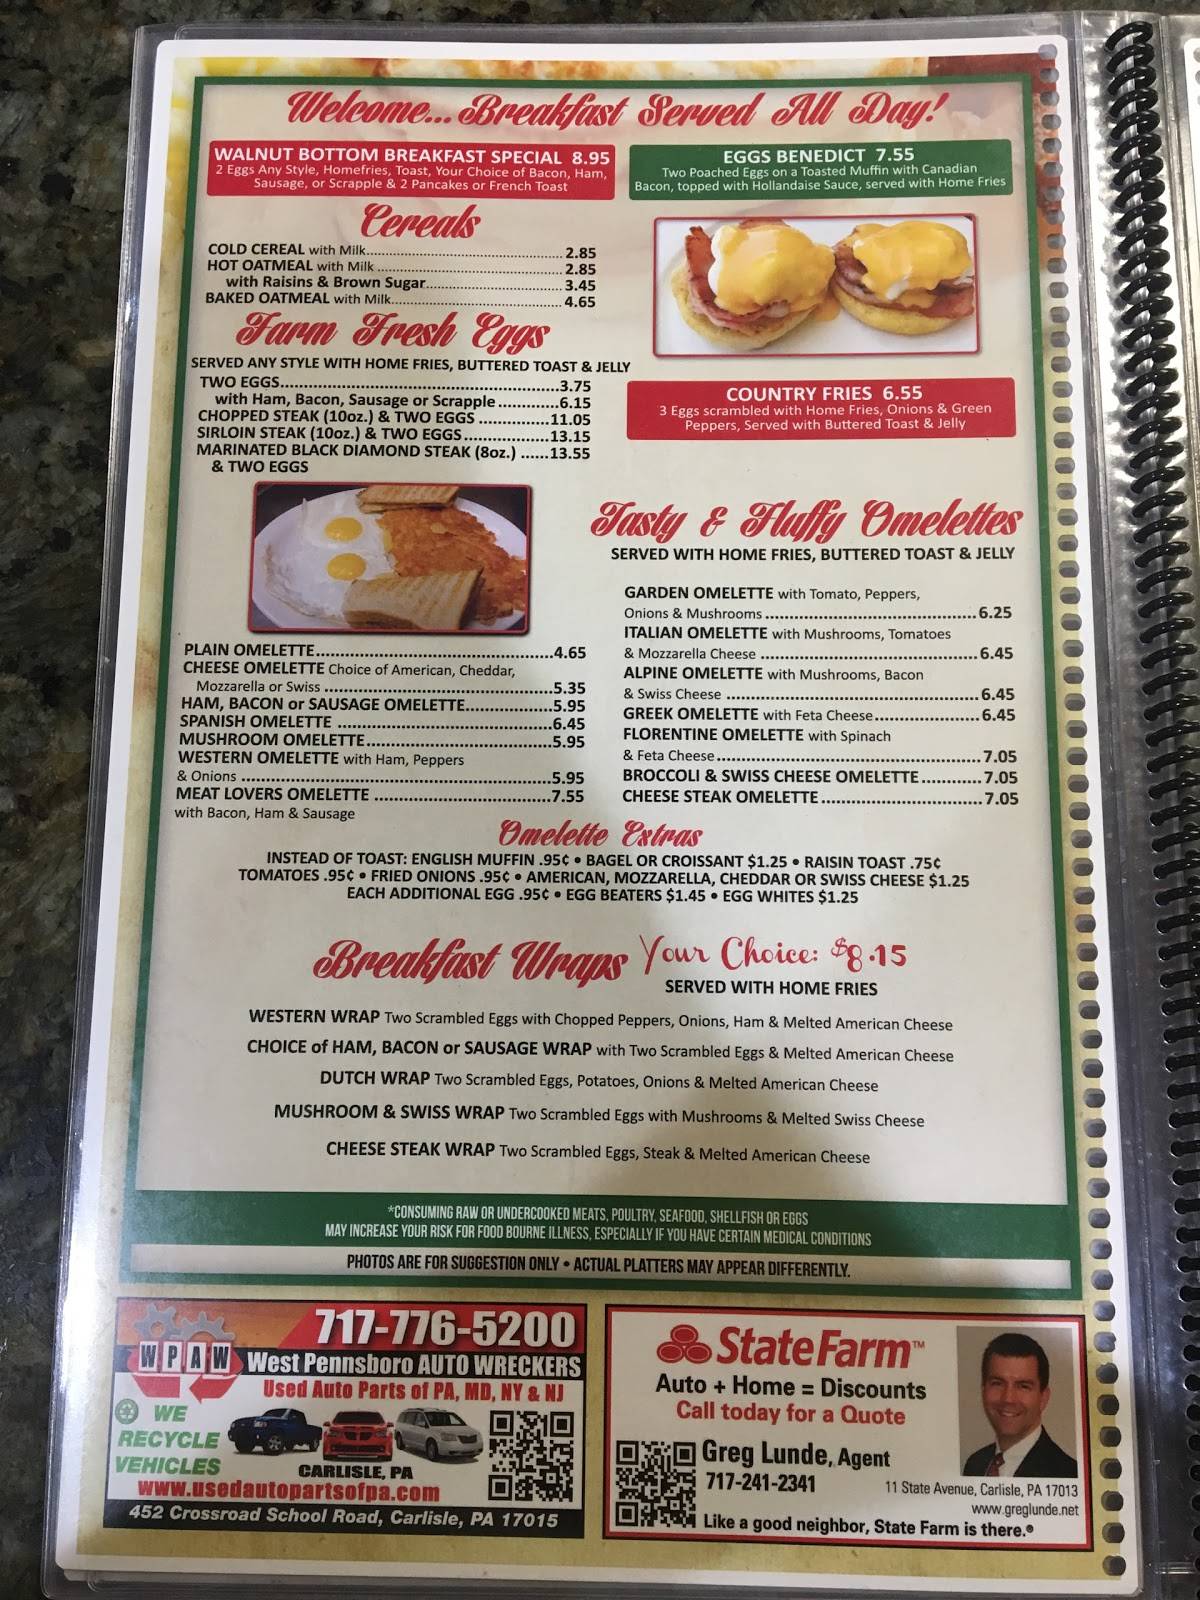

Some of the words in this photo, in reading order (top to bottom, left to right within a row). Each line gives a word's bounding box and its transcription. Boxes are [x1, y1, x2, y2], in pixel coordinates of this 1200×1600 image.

[458, 92, 629, 130] Breakfast
[638, 93, 766, 127] Served
[771, 91, 840, 126] All
[848, 92, 949, 129] Day!
[214, 147, 293, 160] WALNUT
[299, 148, 378, 161] BOTTOM
[385, 148, 486, 162] BREAKFAST
[491, 150, 562, 164] SPECIAL
[572, 151, 609, 164] 8.95
[724, 150, 770, 163] EGGS
[777, 149, 865, 162] BENEDICT
[876, 148, 913, 161] 7.55
[216, 164, 222, 174] 2
[227, 164, 254, 176] Eggs
[258, 164, 281, 176] Any
[286, 164, 318, 176] Style,
[324, 164, 392, 179] Homefries,
[395, 165, 430, 179] Toast,
[436, 166, 463, 180] Your
[467, 166, 508, 176] Choice
[512, 167, 525, 177] of
[529, 168, 570, 179] Bacon,
[575, 168, 606, 179] Ham,
[361, 203, 481, 238] Cereals
[236, 312, 337, 345] Farm
[352, 311, 457, 346] Fresh
[472, 312, 550, 354] Eggs
[191, 357, 243, 367] SERVED
[247, 357, 276, 367] ANY
[280, 357, 318, 368] STYLE
[324, 358, 360, 368] WITH
[365, 358, 408, 369] HOME
[413, 359, 452, 371] FRIES,
[458, 359, 528, 371] BUTTERED
[533, 361, 577, 372] TOAST
[581, 361, 592, 372] &
[596, 362, 630, 372] JELLY
[726, 387, 816, 401] COUNTRY
[823, 386, 872, 400] FRIES
[883, 386, 922, 399] 6.55
[590, 502, 687, 543] Tasty
[700, 506, 727, 536] &
[740, 499, 847, 544] Fluffy
[861, 498, 1023, 536] Omelettes
[624, 586, 688, 598] GARDEN
[694, 587, 773, 599] OMELETTE
[778, 588, 805, 598] with
[810, 588, 860, 600] Tomato,
[865, 588, 919, 601] Peppers,
[183, 661, 239, 673] CHEESE
[244, 661, 324, 674] OMELETTE
[328, 663, 370, 674] Choice
[375, 663, 388, 674] of
[391, 664, 454, 677] American,
[459, 664, 514, 677] Cheddar,
[174, 806, 202, 817] with
[208, 807, 249, 820] Bacon,
[254, 807, 284, 818] Ham
[288, 807, 298, 818] &
[302, 807, 354, 821] Sausage
[499, 820, 608, 846] Omelette
[622, 820, 703, 846] Extras
[347, 886, 385, 898] EACH
[390, 887, 480, 899] ADDITIONAL
[485, 888, 513, 900] EGG
[567, 888, 595, 900] EGG
[601, 889, 661, 901] BEATERS
[666, 888, 705, 903] $1.45
[723, 890, 752, 902] EGG
[757, 890, 813, 902] WHITES
[818, 889, 858, 904] $1.25
[313, 938, 502, 984] Breakfast
[511, 941, 628, 988] Wraps
[640, 935, 709, 974] Your
[721, 936, 817, 970] Choice:
[665, 979, 725, 993] SERVED
[731, 980, 773, 993] WITH
[780, 981, 829, 994] HOME
[835, 982, 877, 995] FRIES
[320, 1070, 375, 1084] DUTCH
[380, 1071, 430, 1084] WRAP
[434, 1073, 461, 1085] Two
[466, 1073, 534, 1085] Scrambled
[540, 1074, 572, 1088] Eggs,
[578, 1074, 638, 1089] Potatoes,
[643, 1075, 689, 1088] Onions
[694, 1076, 704, 1088] &
[710, 1076, 756, 1089] Melted
[761, 1078, 824, 1090] American
[830, 1078, 878, 1091] Cheese
[456, 1206, 478, 1218] RAW
[481, 1206, 494, 1219] OR
[497, 1206, 569, 1220] UNDERCOOKED
[573, 1207, 608, 1221] MEATS,
[612, 1208, 656, 1222] POULTRY,
[660, 1209, 706, 1223] SEAFOOD,
[710, 1210, 763, 1223] SHELLFISH
[766, 1211, 779, 1224] OR
[783, 1212, 808, 1225] EGGS
[315, 1309, 575, 1347] 717-776-5200
[247, 1352, 300, 1374] West
[304, 1353, 414, 1376] Pennsboro
[418, 1355, 469, 1375] AUTO
[473, 1357, 581, 1377] WRECKERS
[154, 1405, 187, 1421] WE
[676, 1400, 714, 1418] Call
[720, 1402, 780, 1425] today
[786, 1403, 815, 1422] for
[822, 1409, 833, 1422] a
[841, 1404, 905, 1424] Quote
[117, 1431, 220, 1449] RECYCLE
[702, 1439, 753, 1468] Greg
[762, 1441, 832, 1467] Lunde,
[837, 1448, 889, 1470] Agent
[114, 1457, 221, 1475] VEHICLES
[298, 1464, 385, 1482] CARLISLE,
[390, 1466, 413, 1479] PA
[137, 1479, 440, 1502] www.usedautopartsofpa.com
[706, 1472, 814, 1492] 717-241-2341
[886, 1481, 896, 1492] 11
[901, 1480, 930, 1493] State
[933, 1482, 976, 1496] Avenue,
[980, 1482, 1023, 1497] Carlisle,
[1027, 1483, 1042, 1496] PA
[1046, 1484, 1077, 1497] 17013
[129, 1504, 163, 1518] 452
[170, 1505, 261, 1520] Crossroad
[266, 1507, 327, 1522] School
[332, 1509, 382, 1526] Road,
[390, 1510, 462, 1528] Carlisle,
[470, 1512, 493, 1525] PA
[502, 1513, 558, 1527] 17015
[971, 1503, 1078, 1517] www.greglunde.net
[704, 1514, 735, 1531] Like
[739, 1519, 748, 1531] a
[752, 1516, 792, 1535] good
[796, 1517, 870, 1536] neighbor,
[874, 1519, 918, 1535] State
[922, 1520, 960, 1536] Farm
[964, 1521, 977, 1536] is
